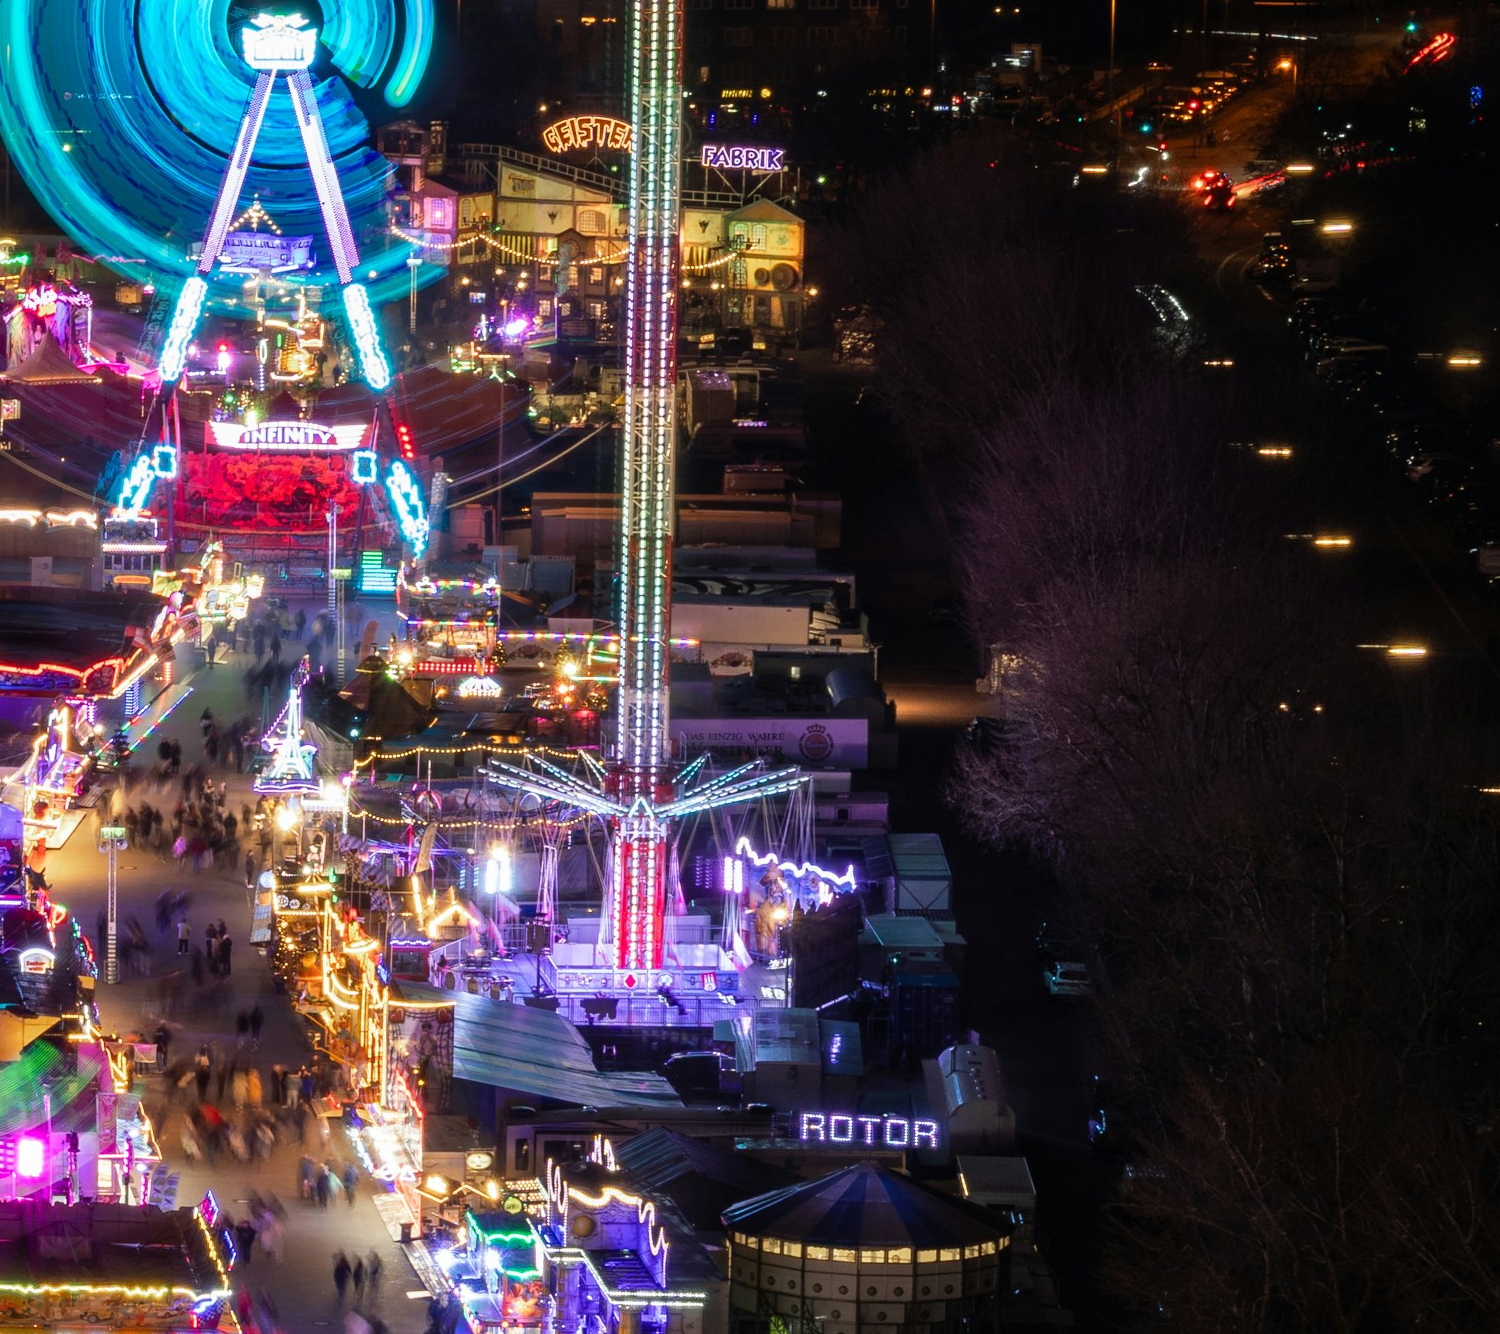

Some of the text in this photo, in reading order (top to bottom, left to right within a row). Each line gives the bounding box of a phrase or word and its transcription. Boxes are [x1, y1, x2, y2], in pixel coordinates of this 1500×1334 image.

[701, 144, 785, 170] FABRIK
[240, 425, 333, 445] INFINITY
[707, 731, 744, 743] EINZIG
[746, 731, 785, 742] WAHRE
[802, 1113, 938, 1148] ROTOR
